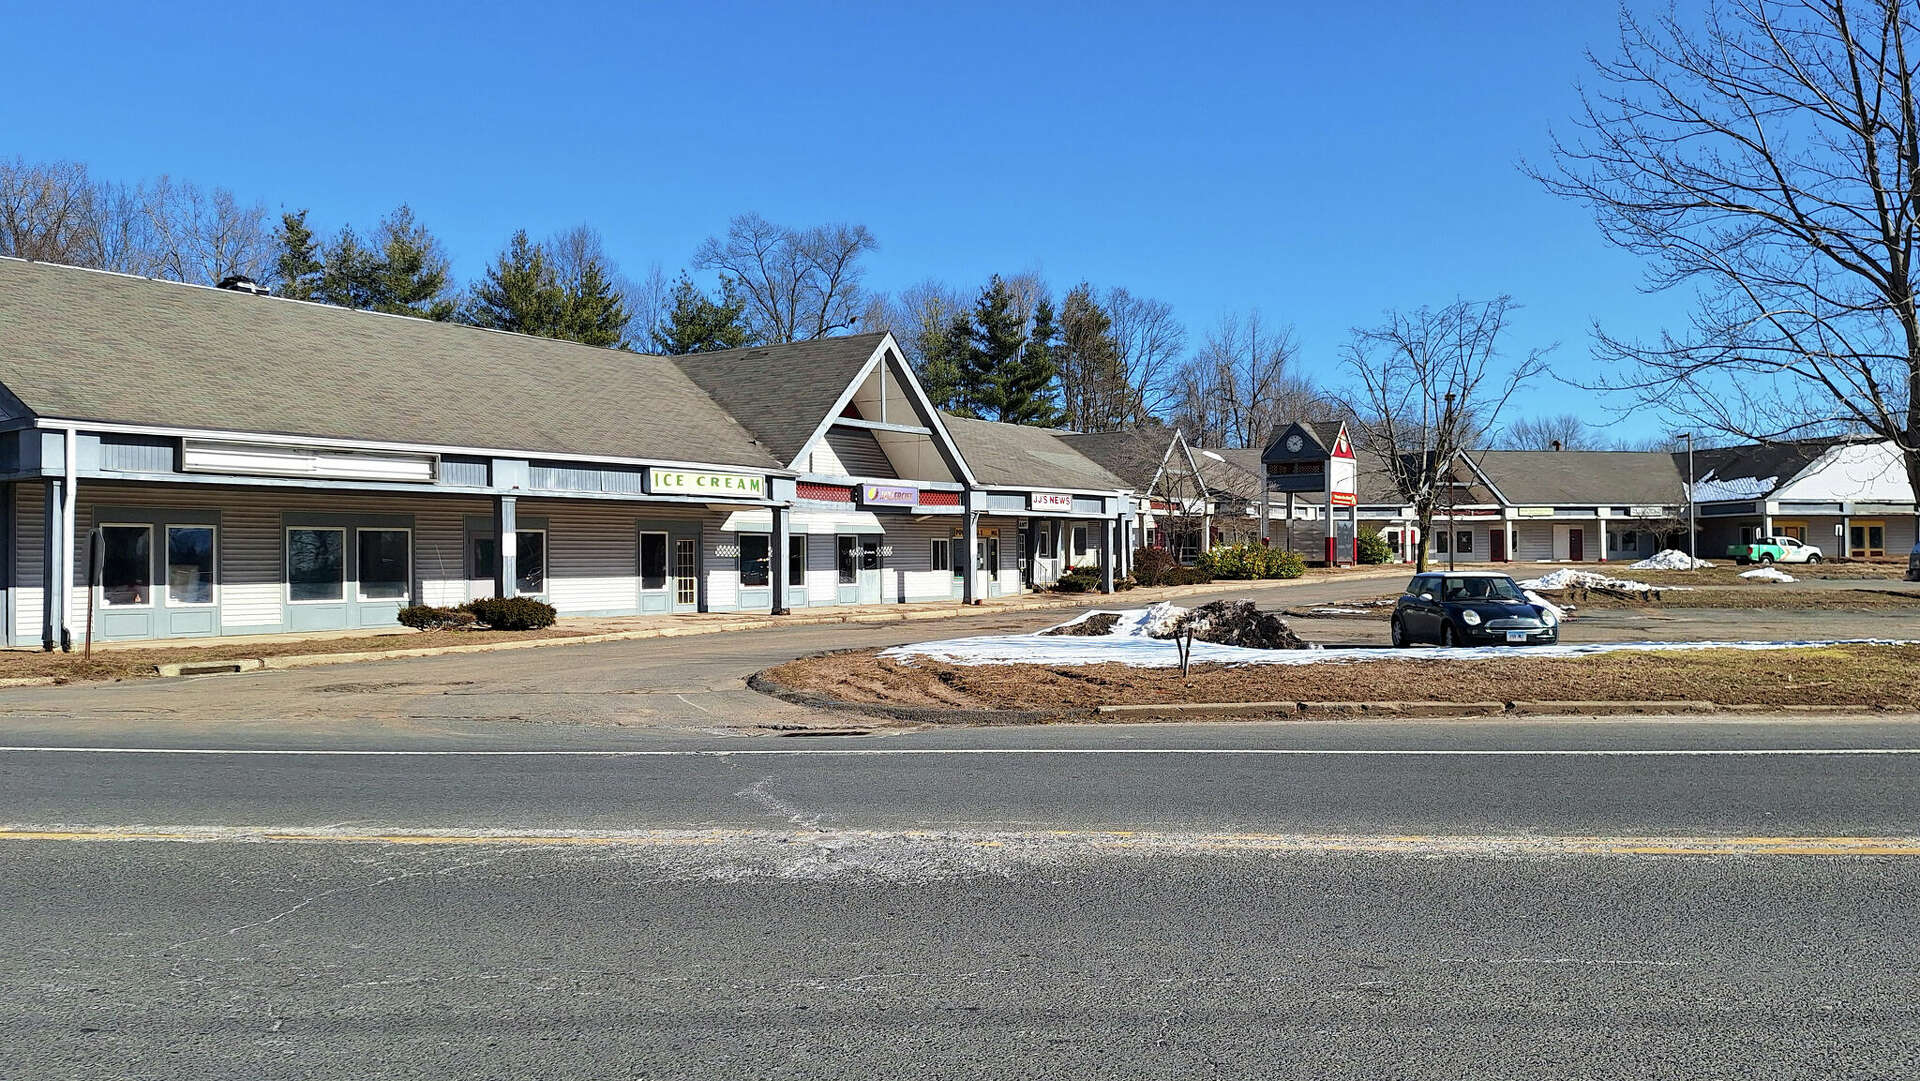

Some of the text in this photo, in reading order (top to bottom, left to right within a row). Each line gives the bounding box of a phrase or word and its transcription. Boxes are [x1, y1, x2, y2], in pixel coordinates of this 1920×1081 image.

[654, 472, 760, 493] ICE CREAM
[1049, 495, 1070, 505] NEWS
